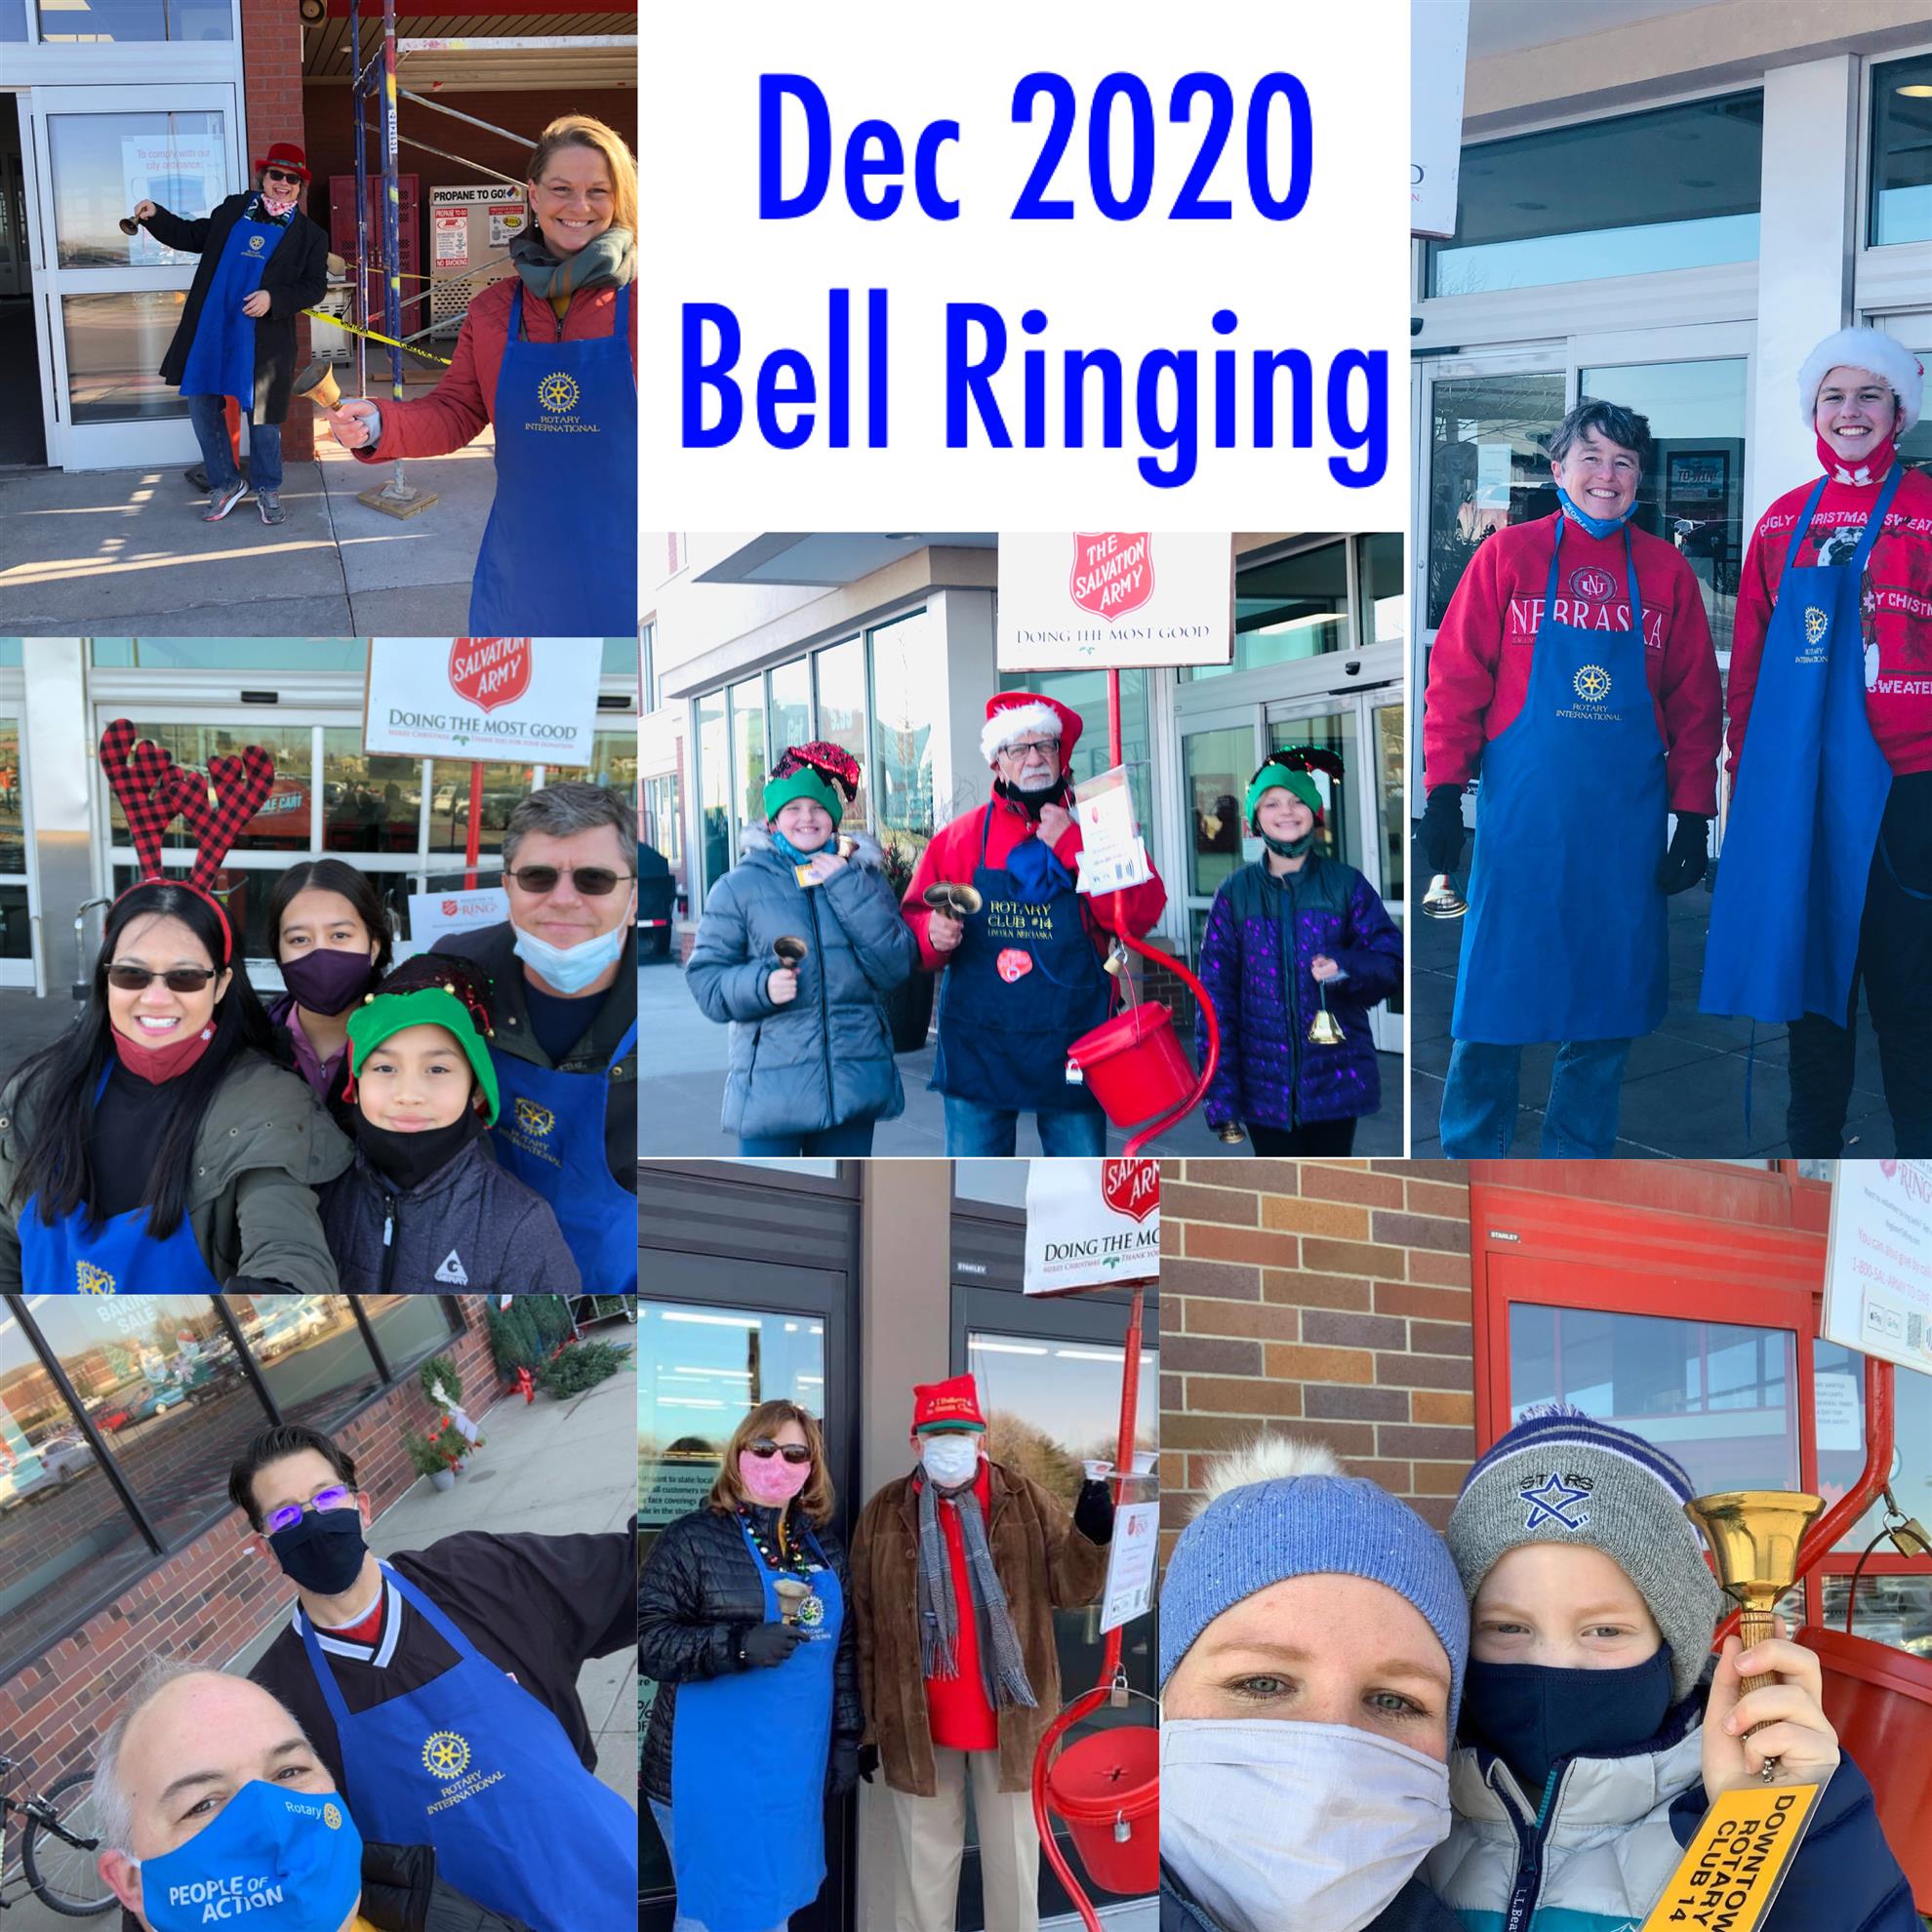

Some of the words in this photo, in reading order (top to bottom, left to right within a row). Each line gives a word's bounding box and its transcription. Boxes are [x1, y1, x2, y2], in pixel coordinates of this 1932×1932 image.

[434, 190, 475, 202] PROPANE
[477, 189, 489, 200] TO
[491, 189, 506, 199] GO!
[525, 423, 601, 433] INTERNATIONAL
[1565, 502, 1588, 532] PEOPLE
[1086, 534, 1118, 566] THE
[1075, 537, 1145, 599] SALVATION
[1100, 565, 1144, 610] ARMY
[1017, 630, 1070, 644] DOING
[1077, 629, 1102, 642] THE
[1108, 627, 1151, 641] MOST
[1158, 625, 1210, 640] GOOD
[454, 637, 525, 682] SALVATION
[476, 656, 523, 699] ARMY
[1868, 680, 1932, 694] SWEATE
[1555, 709, 1623, 721] INTERNATIONAL
[1572, 703, 1609, 712] ROTARY
[389, 708, 447, 730] DOING
[450, 716, 480, 733] THE
[484, 719, 528, 736] MOST
[530, 725, 578, 740] GOOD
[987, 913, 1026, 928] CLUB
[990, 900, 1051, 916] ROTARY
[1044, 1238, 1099, 1262] DOING
[1102, 1231, 1134, 1252] THE
[97, 1295, 157, 1323] BAKING
[117, 1306, 153, 1335] SALE
[664, 1497, 698, 1507] coverings
[426, 1771, 506, 1816] INTERNATIONAL
[441, 1769, 482, 1797] ROTARY
[284, 1801, 322, 1820] Rotary
[1689, 1820, 1738, 1887] CLUB
[1711, 1794, 1797, 1932] DOWNTOW
[1693, 1820, 1761, 1927] ROTARY
[169, 1875, 245, 1907] PEOPLE
[247, 1876, 269, 1893] OF
[202, 1884, 284, 1924] ACTION
[1509, 1888, 1528, 1932] L.L.Bea
[1670, 1895, 1695, 1922] 14
